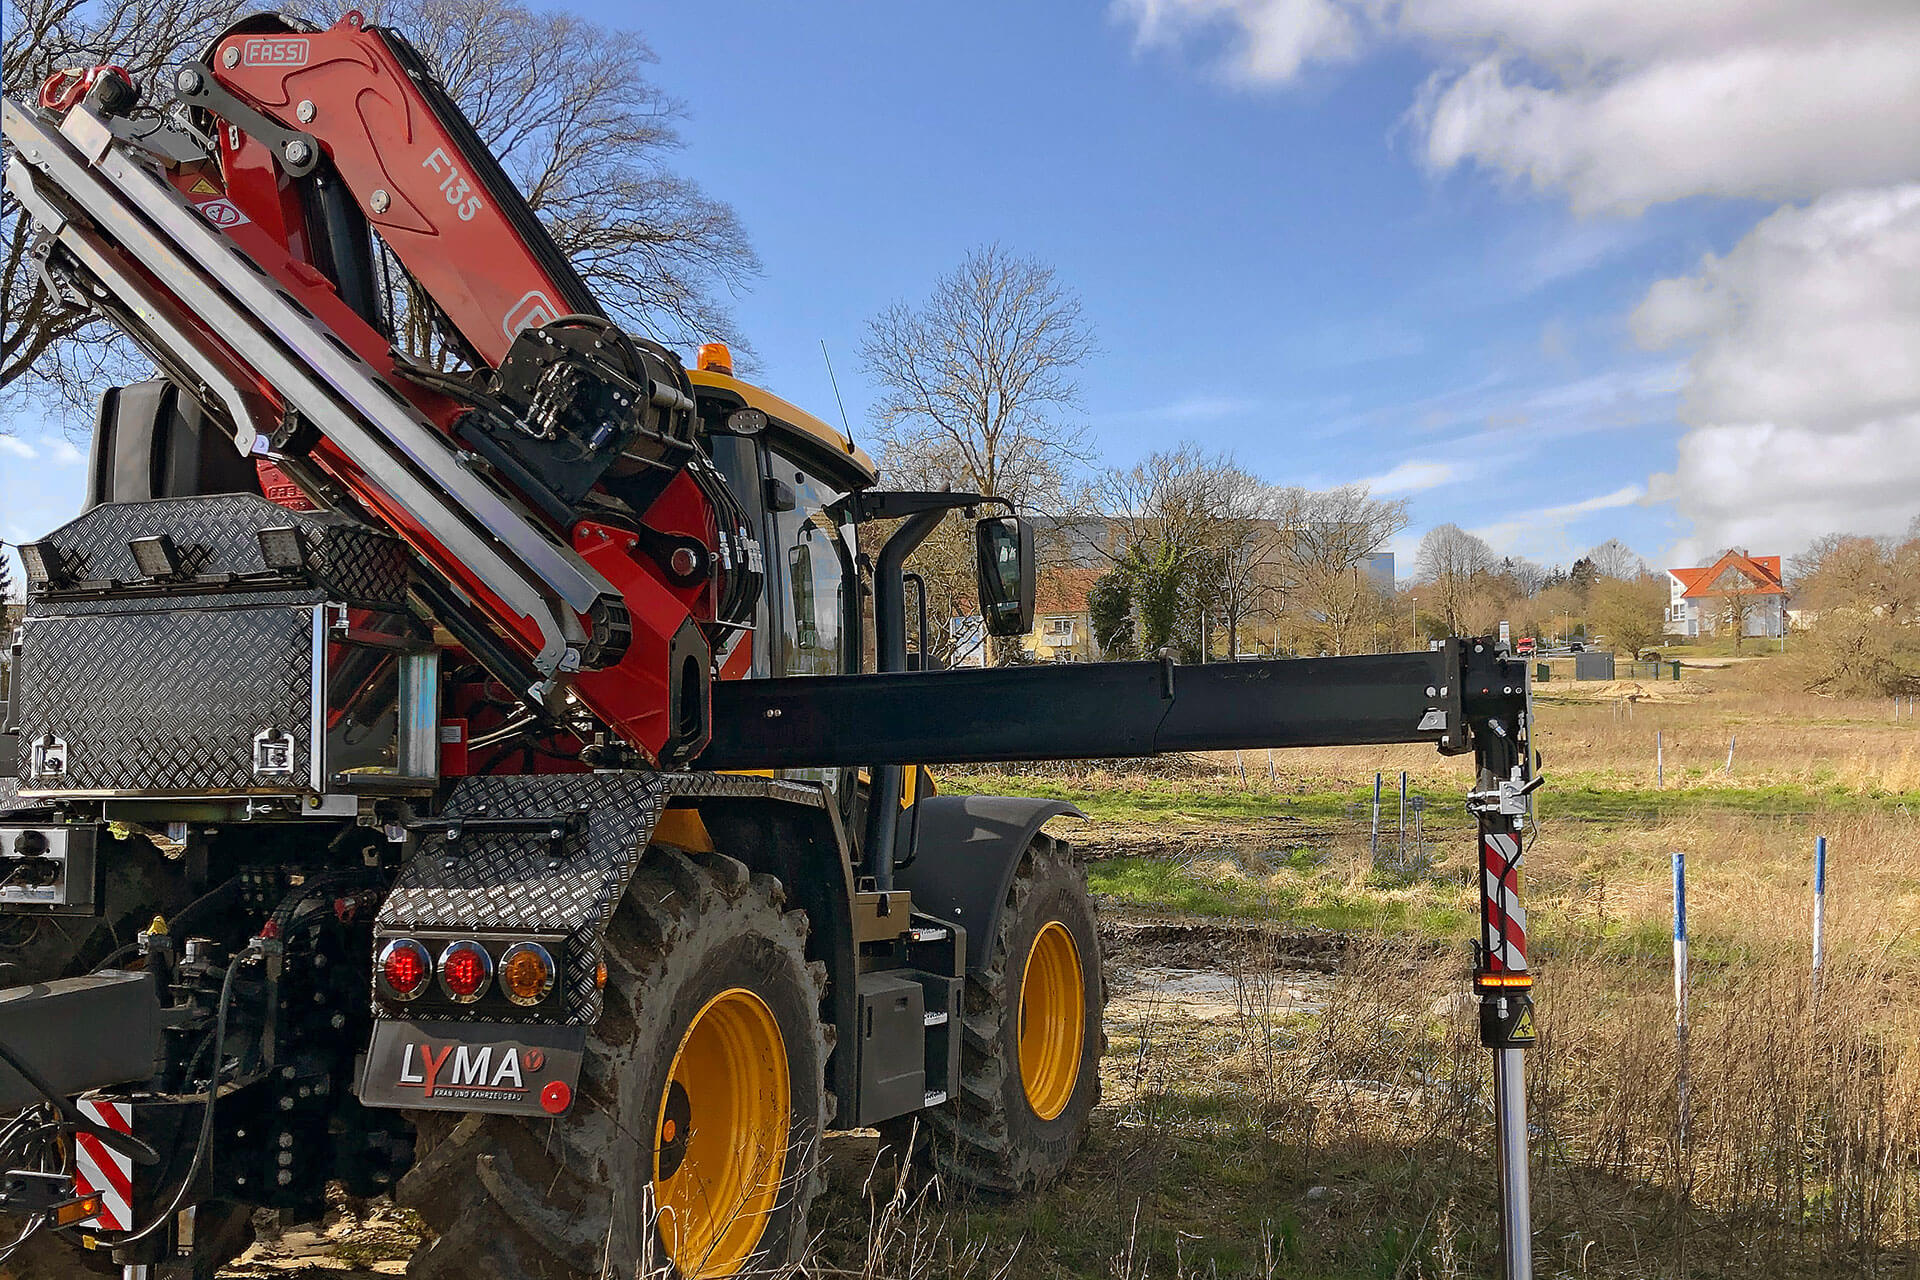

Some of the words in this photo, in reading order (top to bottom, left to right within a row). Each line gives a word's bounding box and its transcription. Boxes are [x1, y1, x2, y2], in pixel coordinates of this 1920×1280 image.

[249, 44, 303, 61] FASSI
[422, 147, 482, 221] F135
[400, 1044, 523, 1098] LYMA
[434, 1088, 453, 1097] KRAN
[454, 1089, 470, 1098] UND
[471, 1090, 522, 1101] FAHRZEUGBAU
